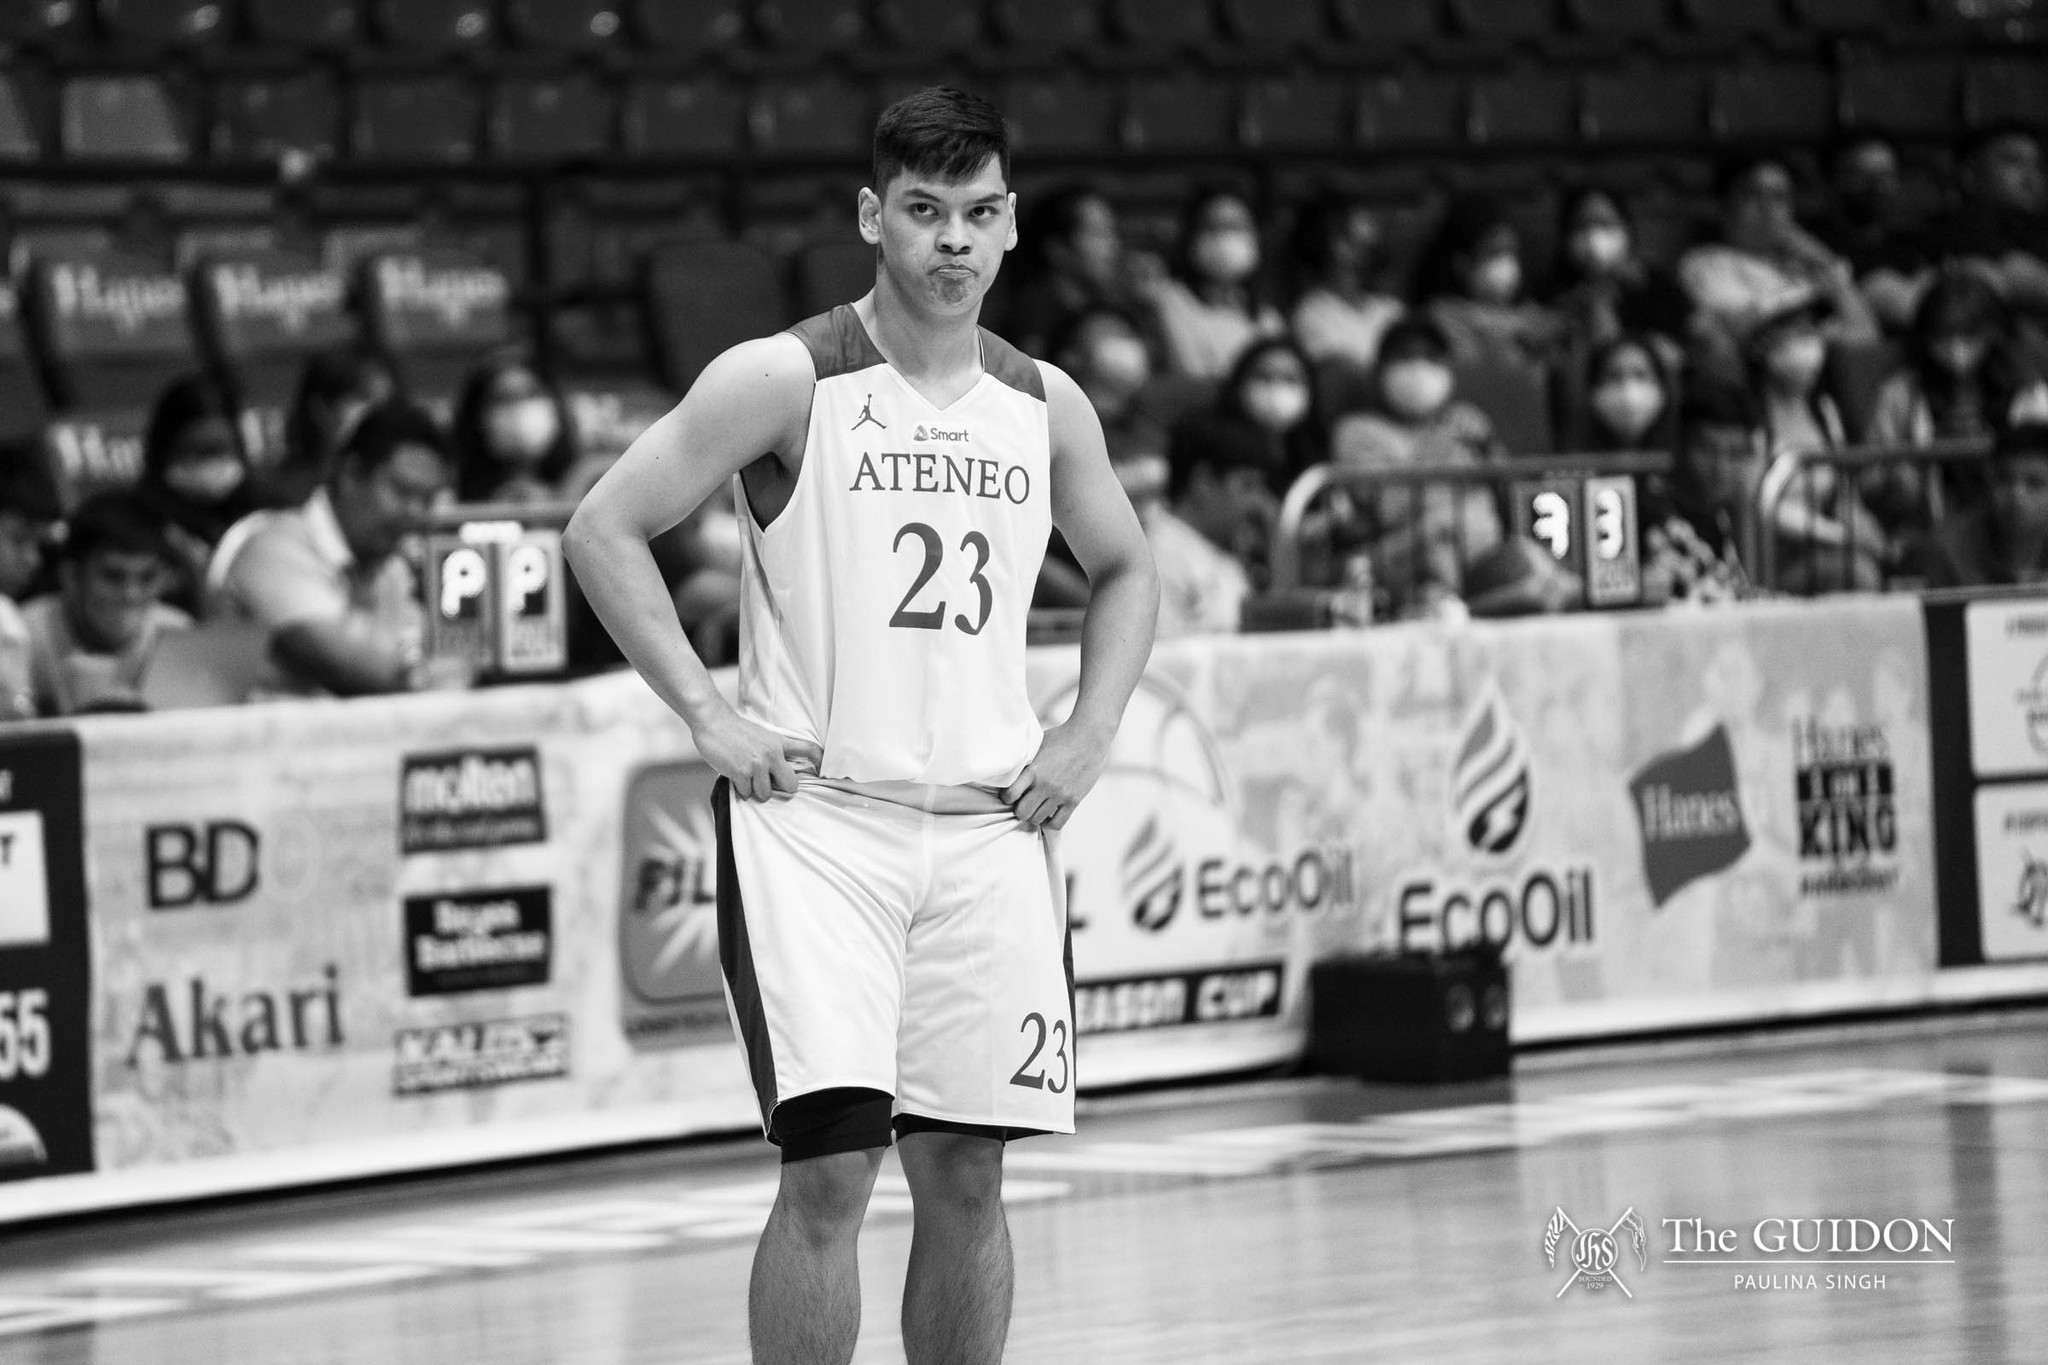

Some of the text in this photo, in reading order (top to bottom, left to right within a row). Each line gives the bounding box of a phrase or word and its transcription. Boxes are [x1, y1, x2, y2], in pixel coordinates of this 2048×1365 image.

[930, 427, 969, 442] Smart
[849, 451, 1030, 504] ATENEO
[889, 522, 993, 635] 23
[1642, 782, 1741, 840] Hanes
[1196, 849, 1353, 920] EcoOil
[1398, 868, 1596, 960] EcoOil
[125, 963, 345, 1067] Akari
[1009, 1011, 1068, 1094] 23
